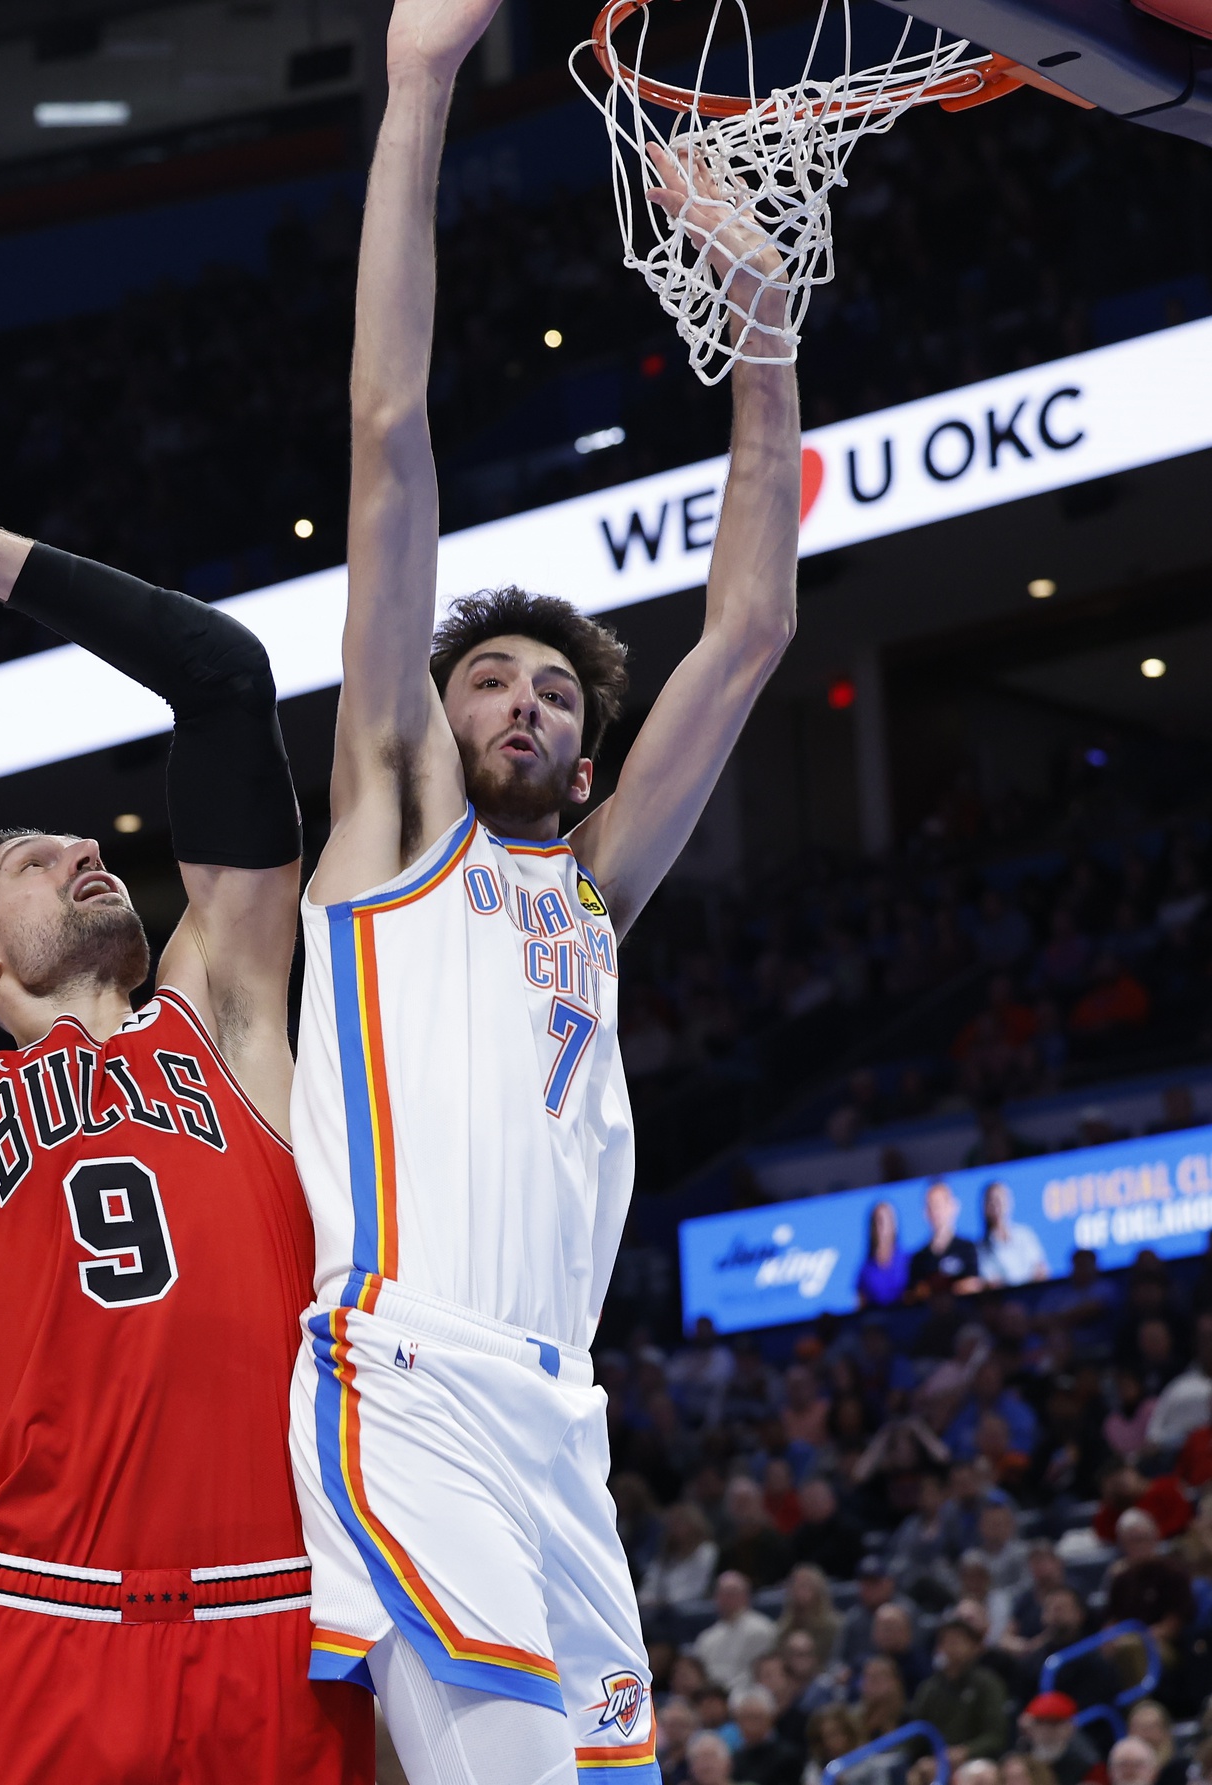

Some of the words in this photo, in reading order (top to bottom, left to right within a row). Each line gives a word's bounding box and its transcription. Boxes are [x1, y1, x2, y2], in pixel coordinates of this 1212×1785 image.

[600, 486, 715, 572] WE
[846, 436, 892, 504] U
[922, 387, 1086, 483] OKC
[543, 995, 599, 1119] 7
[62, 1156, 179, 1309] 9
[599, 1684, 638, 1725] OKC
